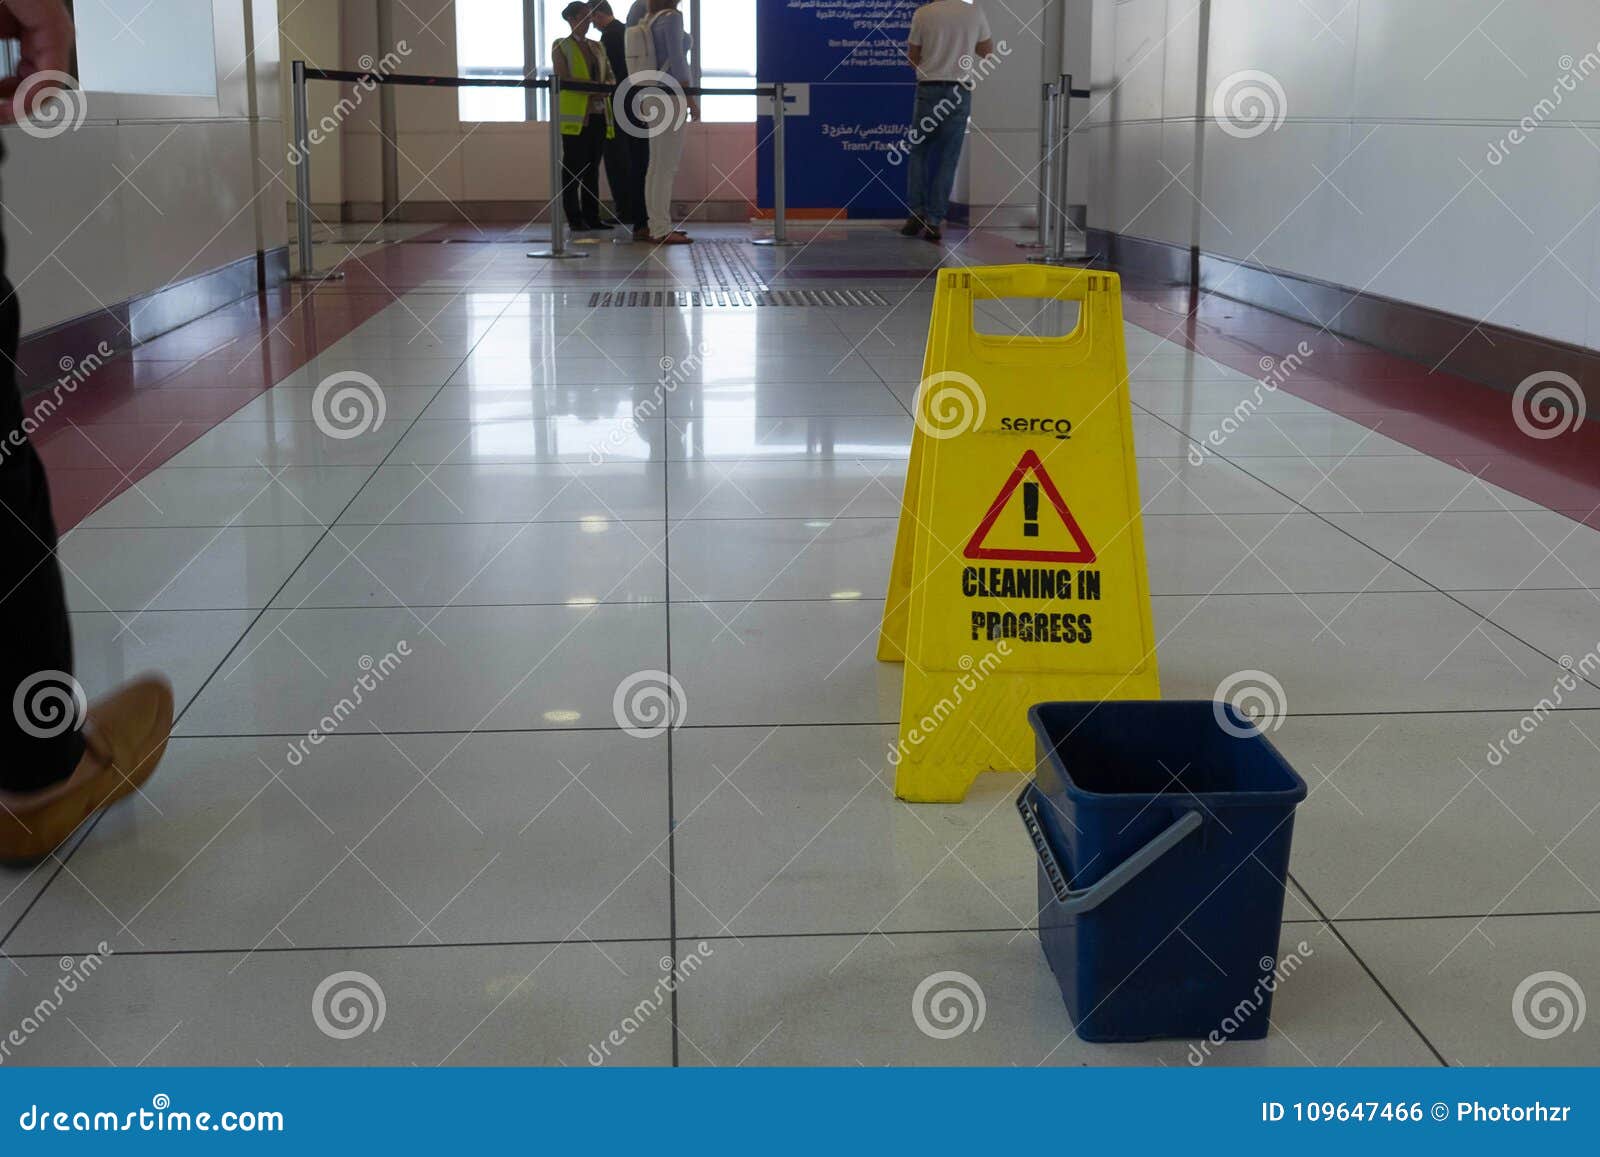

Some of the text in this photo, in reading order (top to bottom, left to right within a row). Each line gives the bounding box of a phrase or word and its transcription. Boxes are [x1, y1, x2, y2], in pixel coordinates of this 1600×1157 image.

[1001, 417, 1071, 439] serco
[962, 566, 1101, 600] CLEANING IN
[971, 611, 1092, 644] PROGRESS
